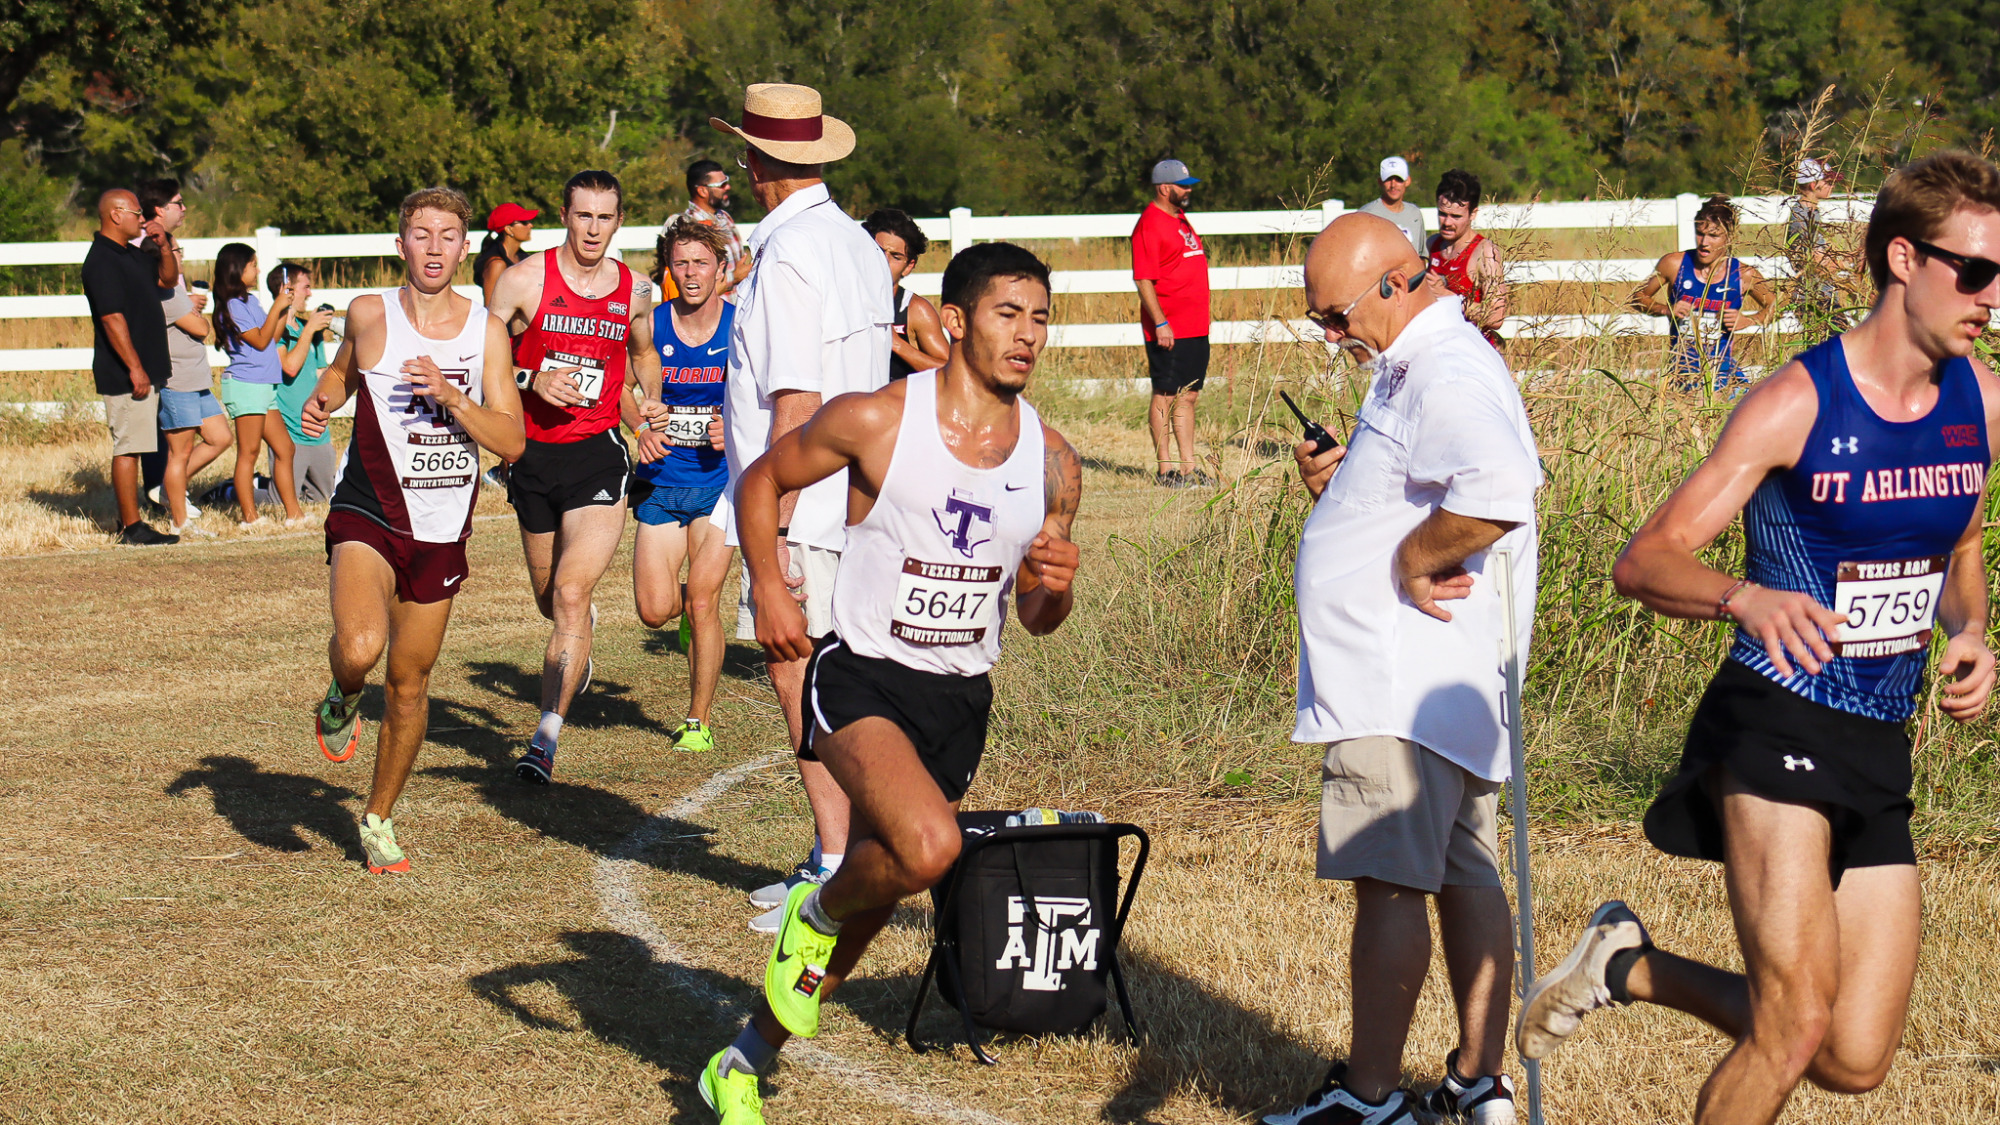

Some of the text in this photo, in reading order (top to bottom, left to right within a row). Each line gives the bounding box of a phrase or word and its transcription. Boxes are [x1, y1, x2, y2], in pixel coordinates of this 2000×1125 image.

[541, 313, 626, 341] ARKANSAS STATE
[554, 352, 579, 363] TEXAS
[420, 435, 448, 444] TEXAS
[411, 451, 471, 472] 5665
[409, 477, 465, 488] INVITATIONAL
[1811, 462, 1984, 503] UT ARLINGTON
[920, 563, 989, 581] TEXAS A&M
[1856, 559, 1931, 580] TEXAS A&M
[905, 587, 988, 620] 5647
[1846, 588, 1930, 629] 5759
[900, 625, 975, 643] INVITATIONAL
[1841, 634, 1921, 658] INVITATIONAL
